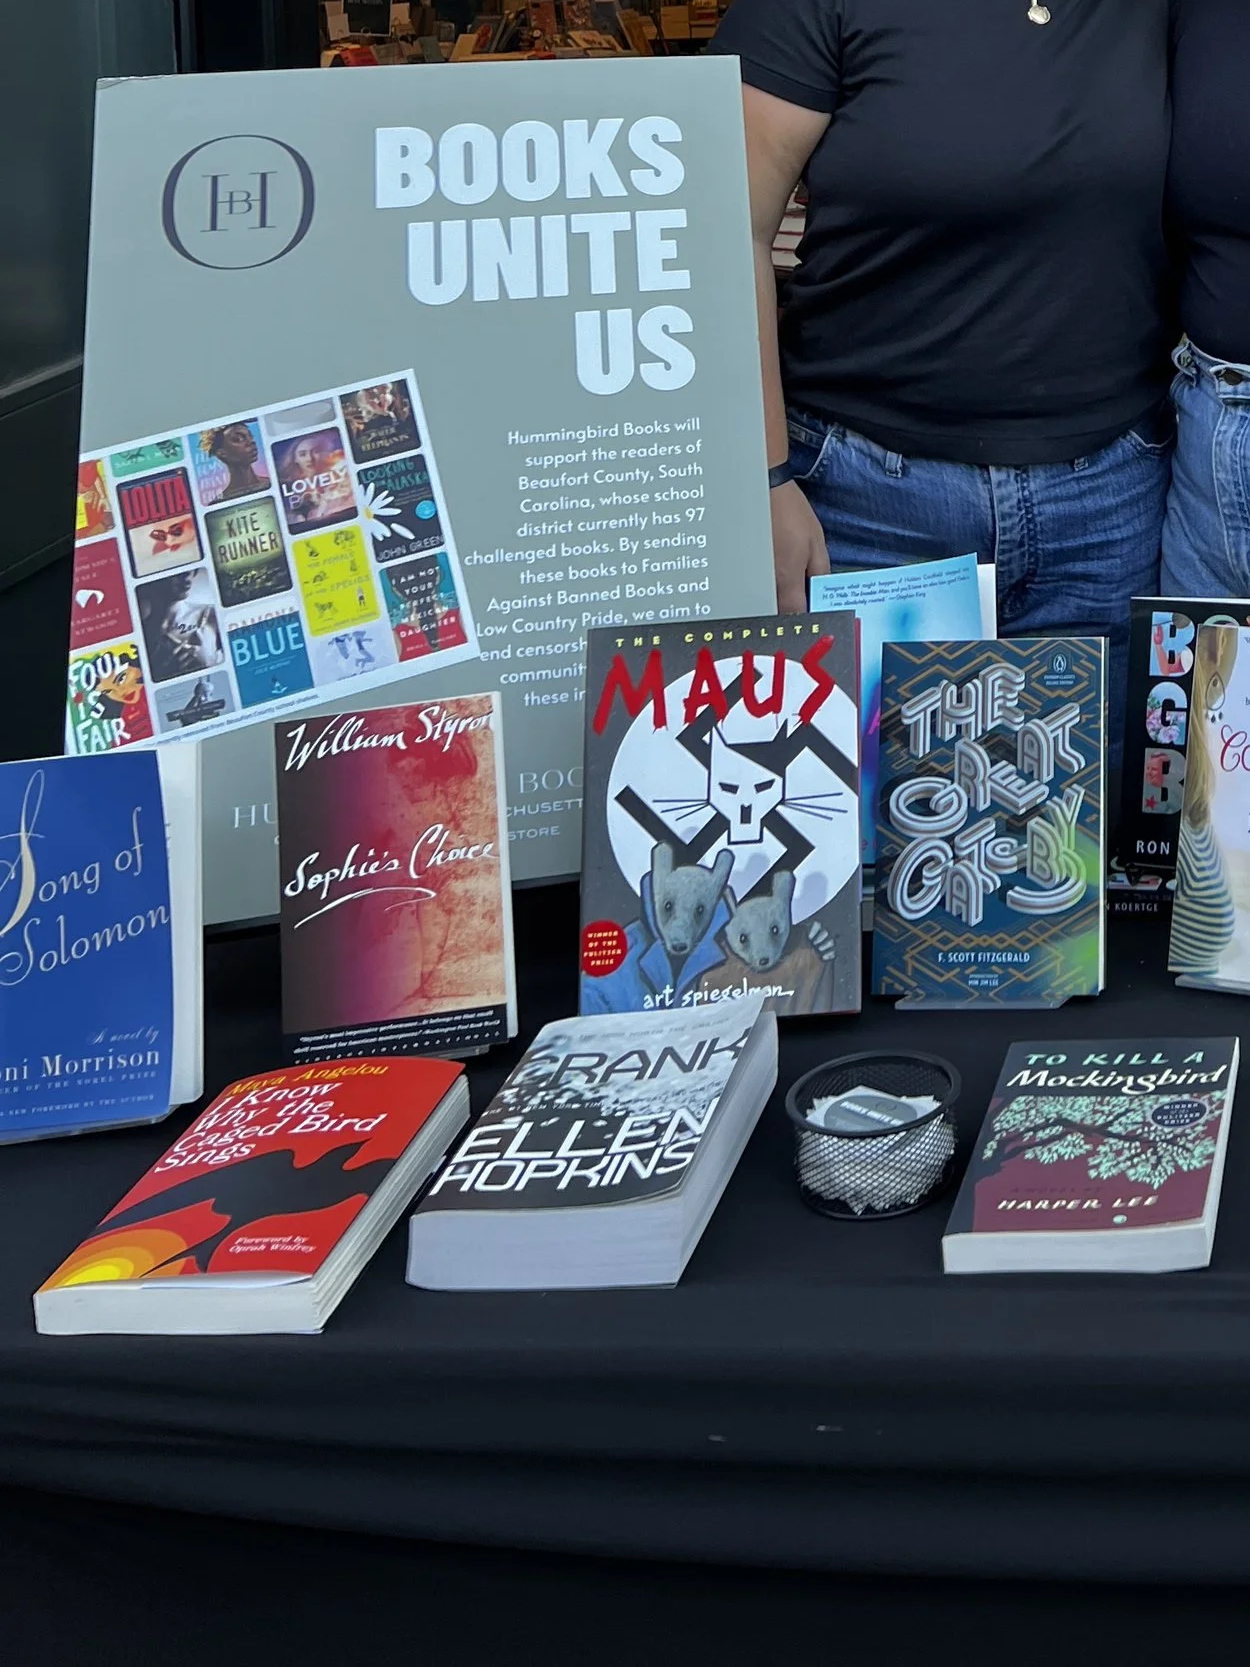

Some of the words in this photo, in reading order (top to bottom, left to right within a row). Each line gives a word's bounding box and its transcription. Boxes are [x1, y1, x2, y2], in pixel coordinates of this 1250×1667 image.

[375, 116, 685, 210] BOOKS
[407, 208, 691, 306] UNITE
[574, 305, 697, 396] US
[508, 423, 619, 445] Hummingbird
[623, 420, 671, 436] Books
[674, 417, 700, 432] will
[525, 449, 587, 468] support
[592, 447, 617, 461] the
[621, 443, 682, 459] readers
[686, 439, 702, 454] of
[282, 466, 348, 497] LOVELY
[518, 472, 589, 490] Beaufort
[593, 468, 654, 484] County,
[658, 462, 703, 478] South
[121, 480, 191, 525] LOLITA
[519, 496, 596, 513] Carolina,
[599, 491, 650, 506] whose
[654, 484, 704, 502] school
[226, 512, 260, 538] KITE
[516, 519, 573, 537] district
[577, 513, 648, 532] currently
[652, 510, 681, 526] has
[685, 507, 706, 522] 97
[218, 534, 280, 564] RUNNER
[231, 622, 305, 667] BLUE
[615, 634, 661, 648] THE
[685, 623, 821, 644] COMPLETE
[68, 653, 131, 693] FOUL
[591, 634, 836, 737] MAUS
[76, 693, 105, 721] IS
[901, 661, 1027, 761] THE
[75, 716, 131, 754] FAIR
[284, 712, 407, 772] William
[414, 705, 493, 755] Styron
[888, 700, 1087, 838] GREAT
[114, 806, 145, 876] of
[887, 784, 1087, 931] GATSBY
[1135, 840, 1170, 855] RON
[284, 842, 402, 900] Sophie's
[408, 822, 500, 880] Choice
[1114, 902, 1159, 912] KOERTGE
[0, 902, 170, 987] Solomon
[938, 951, 946, 963] F.
[947, 951, 975, 963] SCOTT
[978, 951, 1030, 963] FITZGERALD
[643, 984, 675, 1009] art
[681, 981, 795, 1006] spiegelman
[41, 1048, 160, 1078] Morrison
[1025, 1053, 1067, 1066] TO
[1082, 1052, 1169, 1066] KILL
[1183, 1051, 1205, 1064] A
[226, 1075, 286, 1097] Maya
[294, 1063, 389, 1082] Angelou
[1006, 1064, 1228, 1095] Mockingbird
[194, 1106, 269, 1133] Why
[276, 1099, 335, 1118] the
[208, 1096, 231, 1116] I
[232, 1082, 344, 1109] Know
[173, 1116, 292, 1153] Caged
[288, 1112, 388, 1134] Bird
[451, 1096, 719, 1164] ELLEN
[154, 1142, 257, 1174] Sings
[428, 1135, 702, 1197] HOPKINS
[997, 1199, 1102, 1210] HARPER
[1112, 1195, 1159, 1209] LEE
